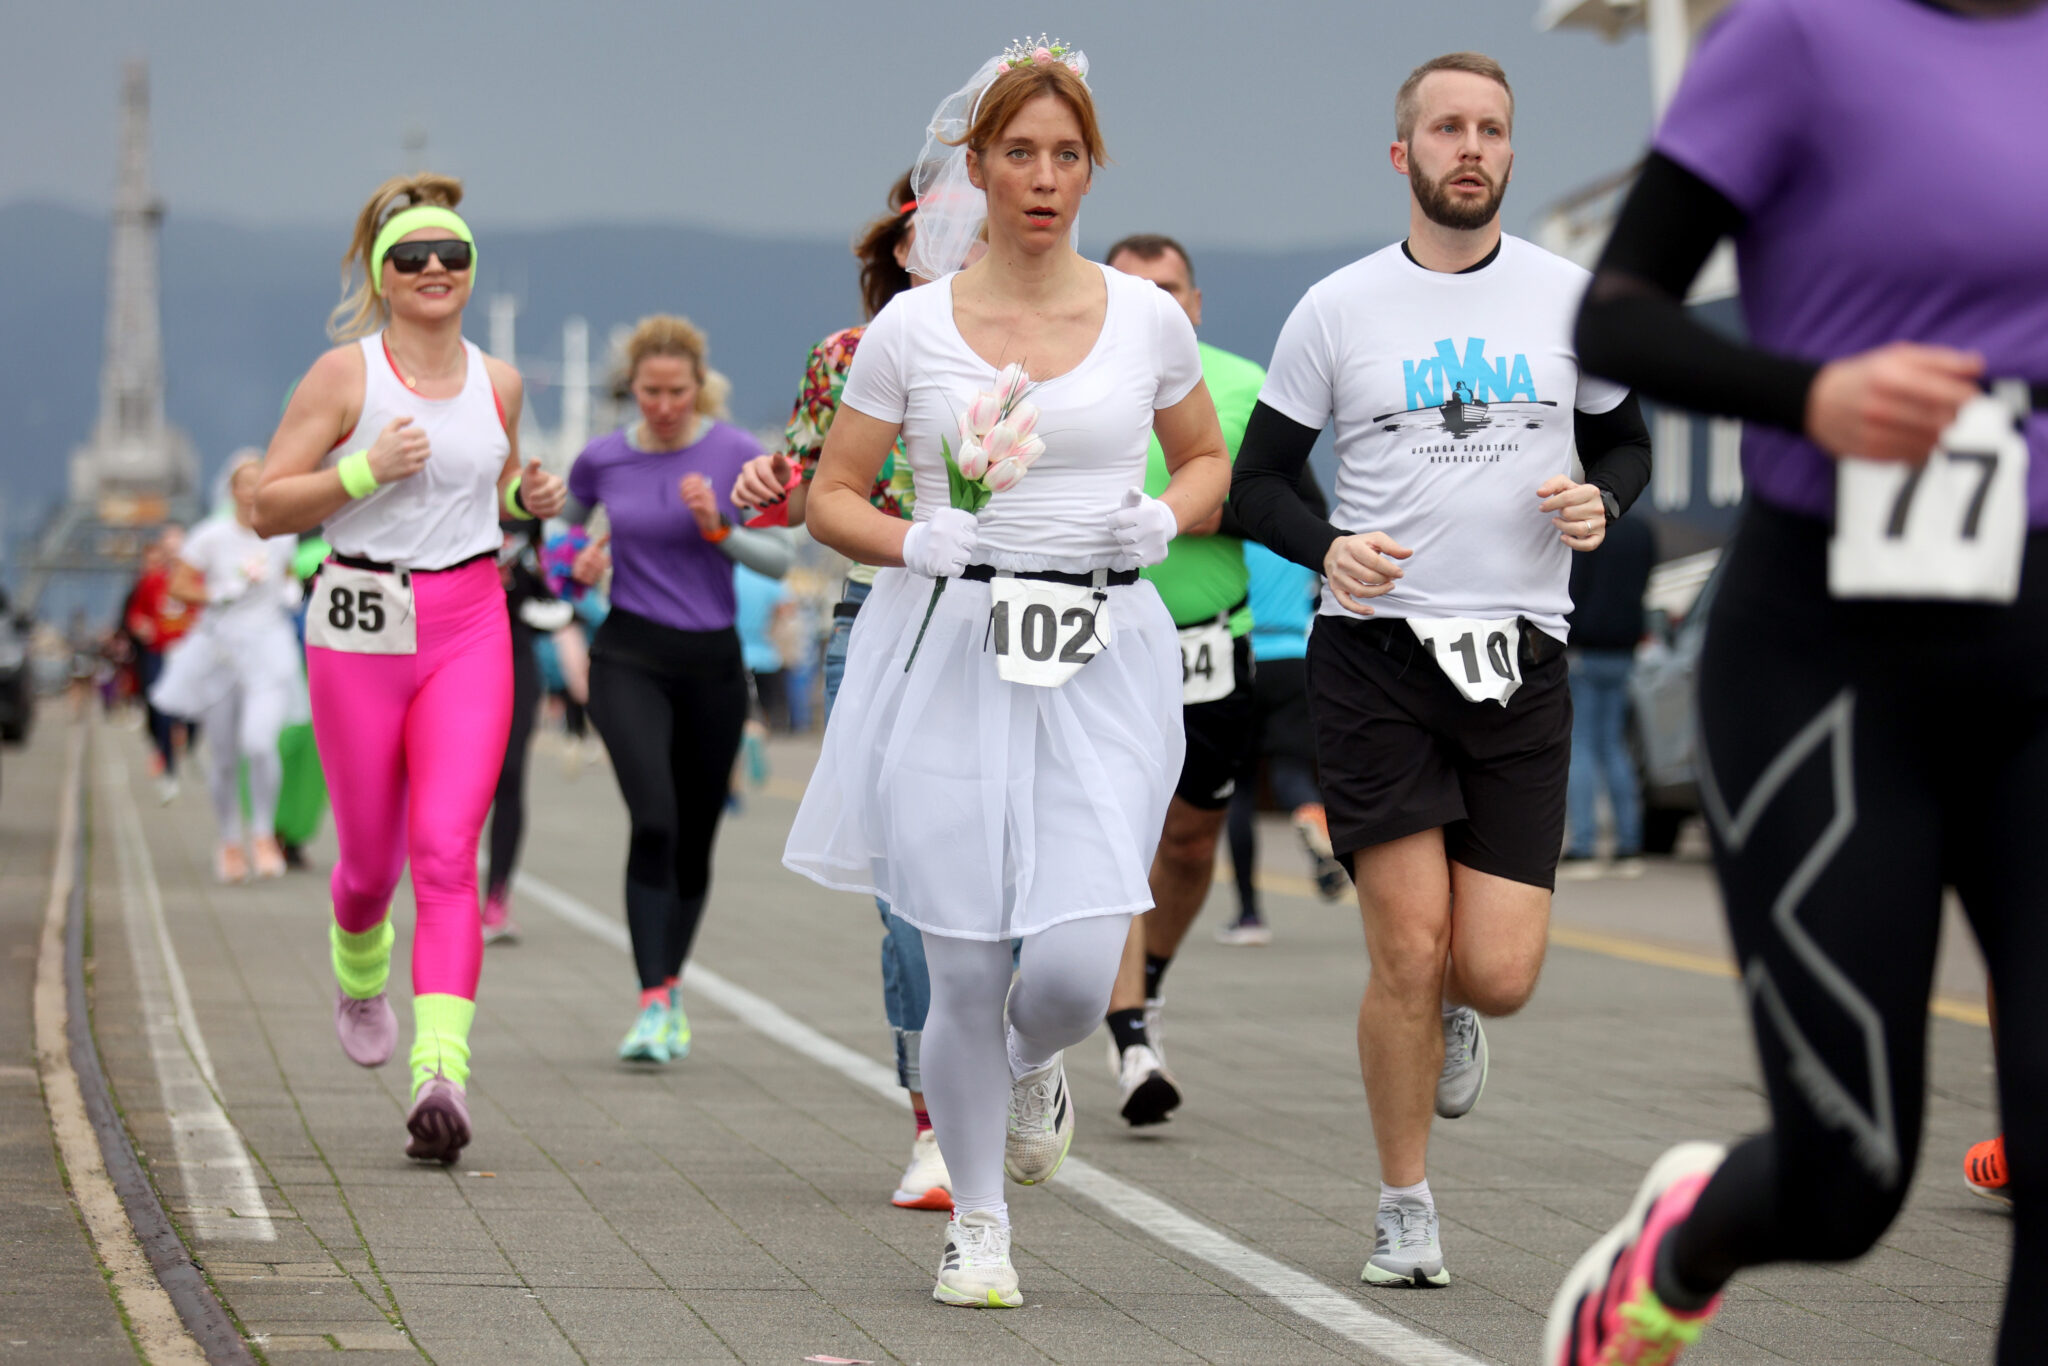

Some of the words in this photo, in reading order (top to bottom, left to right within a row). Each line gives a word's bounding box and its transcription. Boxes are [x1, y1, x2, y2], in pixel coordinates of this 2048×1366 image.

[1411, 445, 1455, 455] UDRUGA
[1463, 443, 1519, 453] SPORTSKE
[1430, 455, 1500, 464] REKREACIJE
[328, 586, 386, 632] 85
[991, 600, 1096, 664] 102
